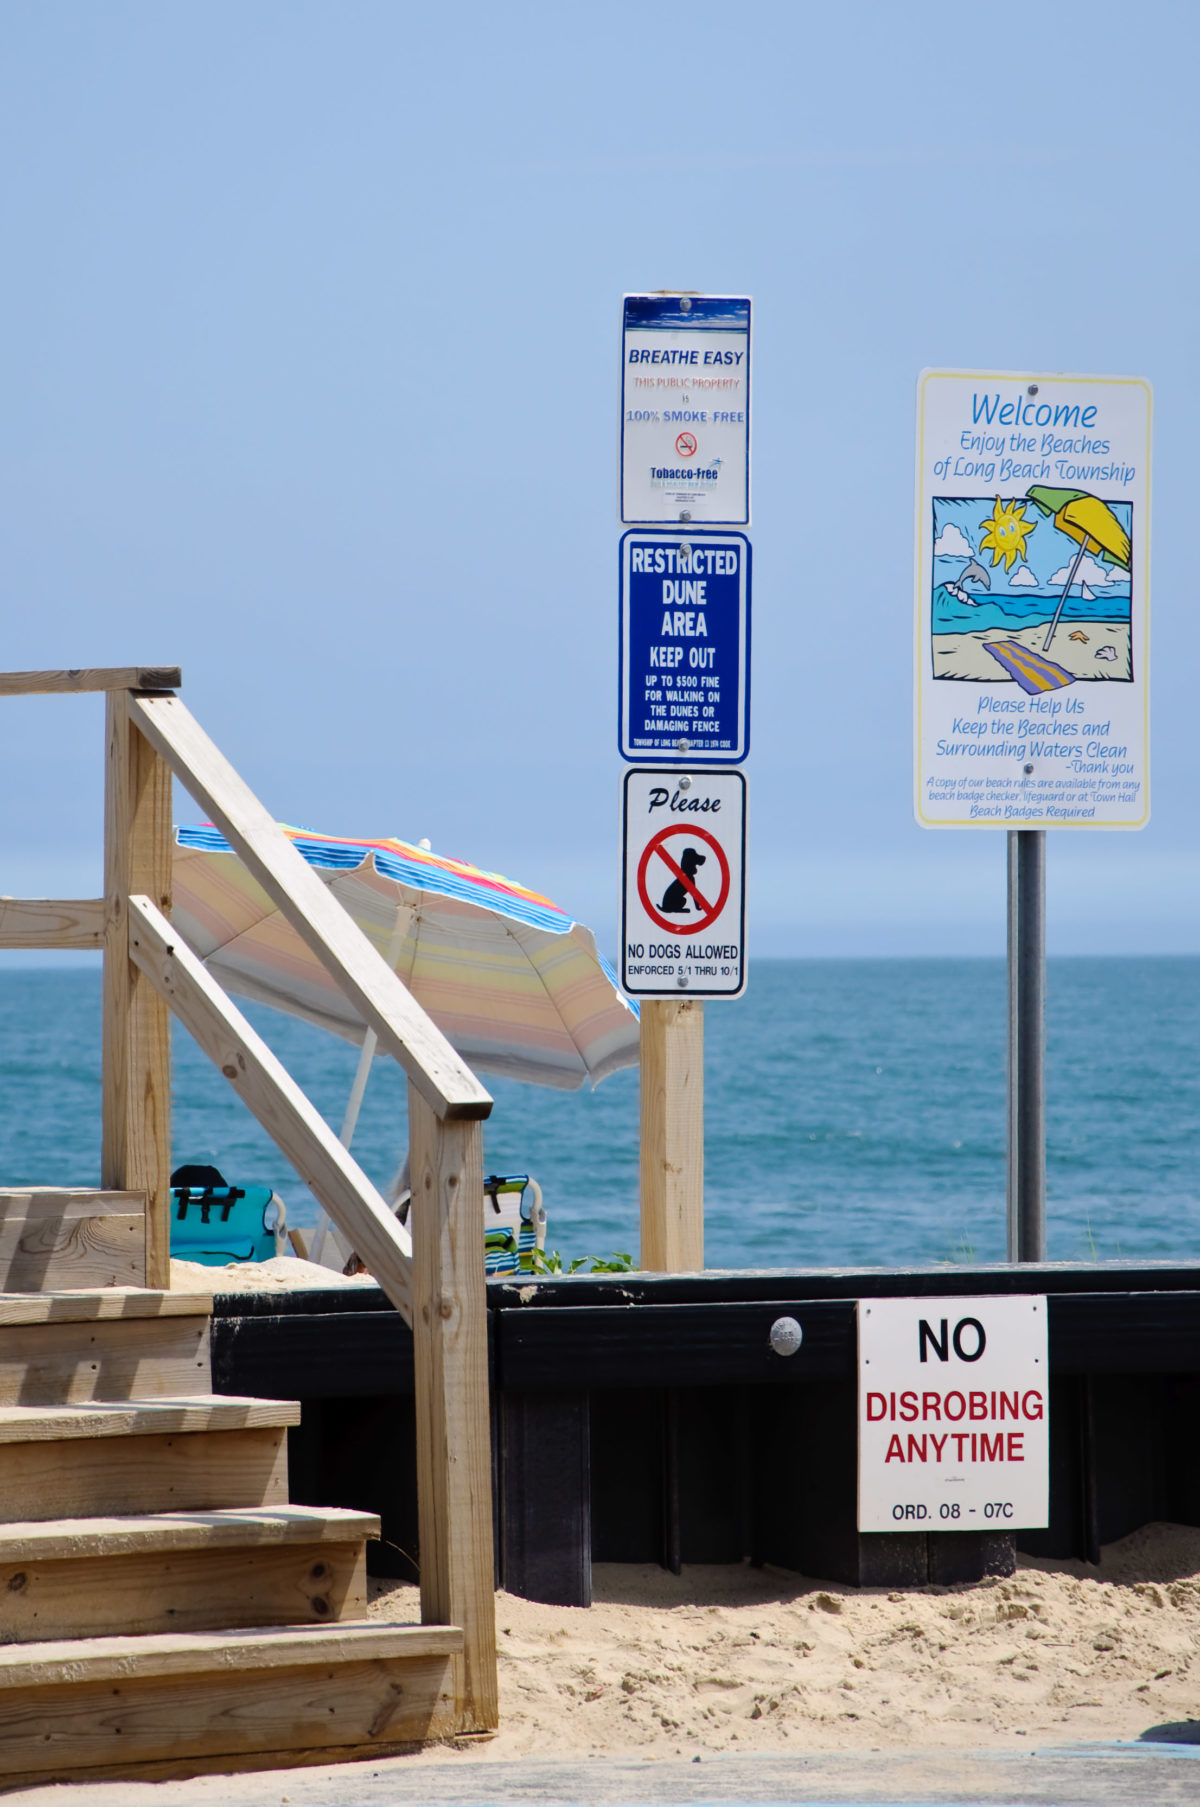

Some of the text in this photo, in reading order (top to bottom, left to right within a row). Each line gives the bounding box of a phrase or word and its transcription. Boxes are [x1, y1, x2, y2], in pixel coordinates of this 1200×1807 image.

[629, 350, 744, 365] BREATHE EASY
[634, 377, 740, 389] THIS PUBLIC PROPERTY
[627, 410, 660, 423] 100%
[972, 393, 1097, 428] Welcome
[960, 431, 1110, 456] Enjoy the Beaches
[934, 456, 1135, 486] of Long Beach Township
[632, 548, 738, 575] RESTRICTED
[662, 580, 707, 605] DUNE
[661, 611, 708, 637] AREA
[650, 646, 716, 668] KEEP OUT
[646, 675, 719, 688] UP TO $500 FINE
[645, 690, 720, 702] FOR WALKING ON
[651, 705, 714, 717] THE DUNES OR
[977, 696, 1085, 717] Please Help Us
[644, 720, 720, 732] DAMAGING FENCE
[952, 718, 1110, 738] Keep the Beaches and
[936, 740, 1127, 761] Surrounding Waters Clean
[1065, 760, 1134, 777] -Thank you
[926, 776, 1140, 792] A copy of our beach rules are available from any
[648, 788, 722, 814] Please
[929, 790, 954, 800] beach
[957, 791, 984, 803] badge
[1024, 791, 1064, 804] lifeguard
[1078, 793, 1088, 801] at
[1090, 792, 1116, 802] Town
[1118, 792, 1136, 802] Hall
[970, 804, 1095, 819] Beach Badges Required
[628, 944, 738, 959] NO DOGS ALLOWED
[628, 966, 738, 976] ENFORCED 5/1 THRU 10/1
[918, 1317, 986, 1363] NO
[866, 1390, 1043, 1421] DISROBING
[885, 1432, 1025, 1463] ANYTIME
[892, 1504, 931, 1520] ORD.
[939, 1503, 960, 1519] 08
[984, 1502, 1013, 1518] 07C
